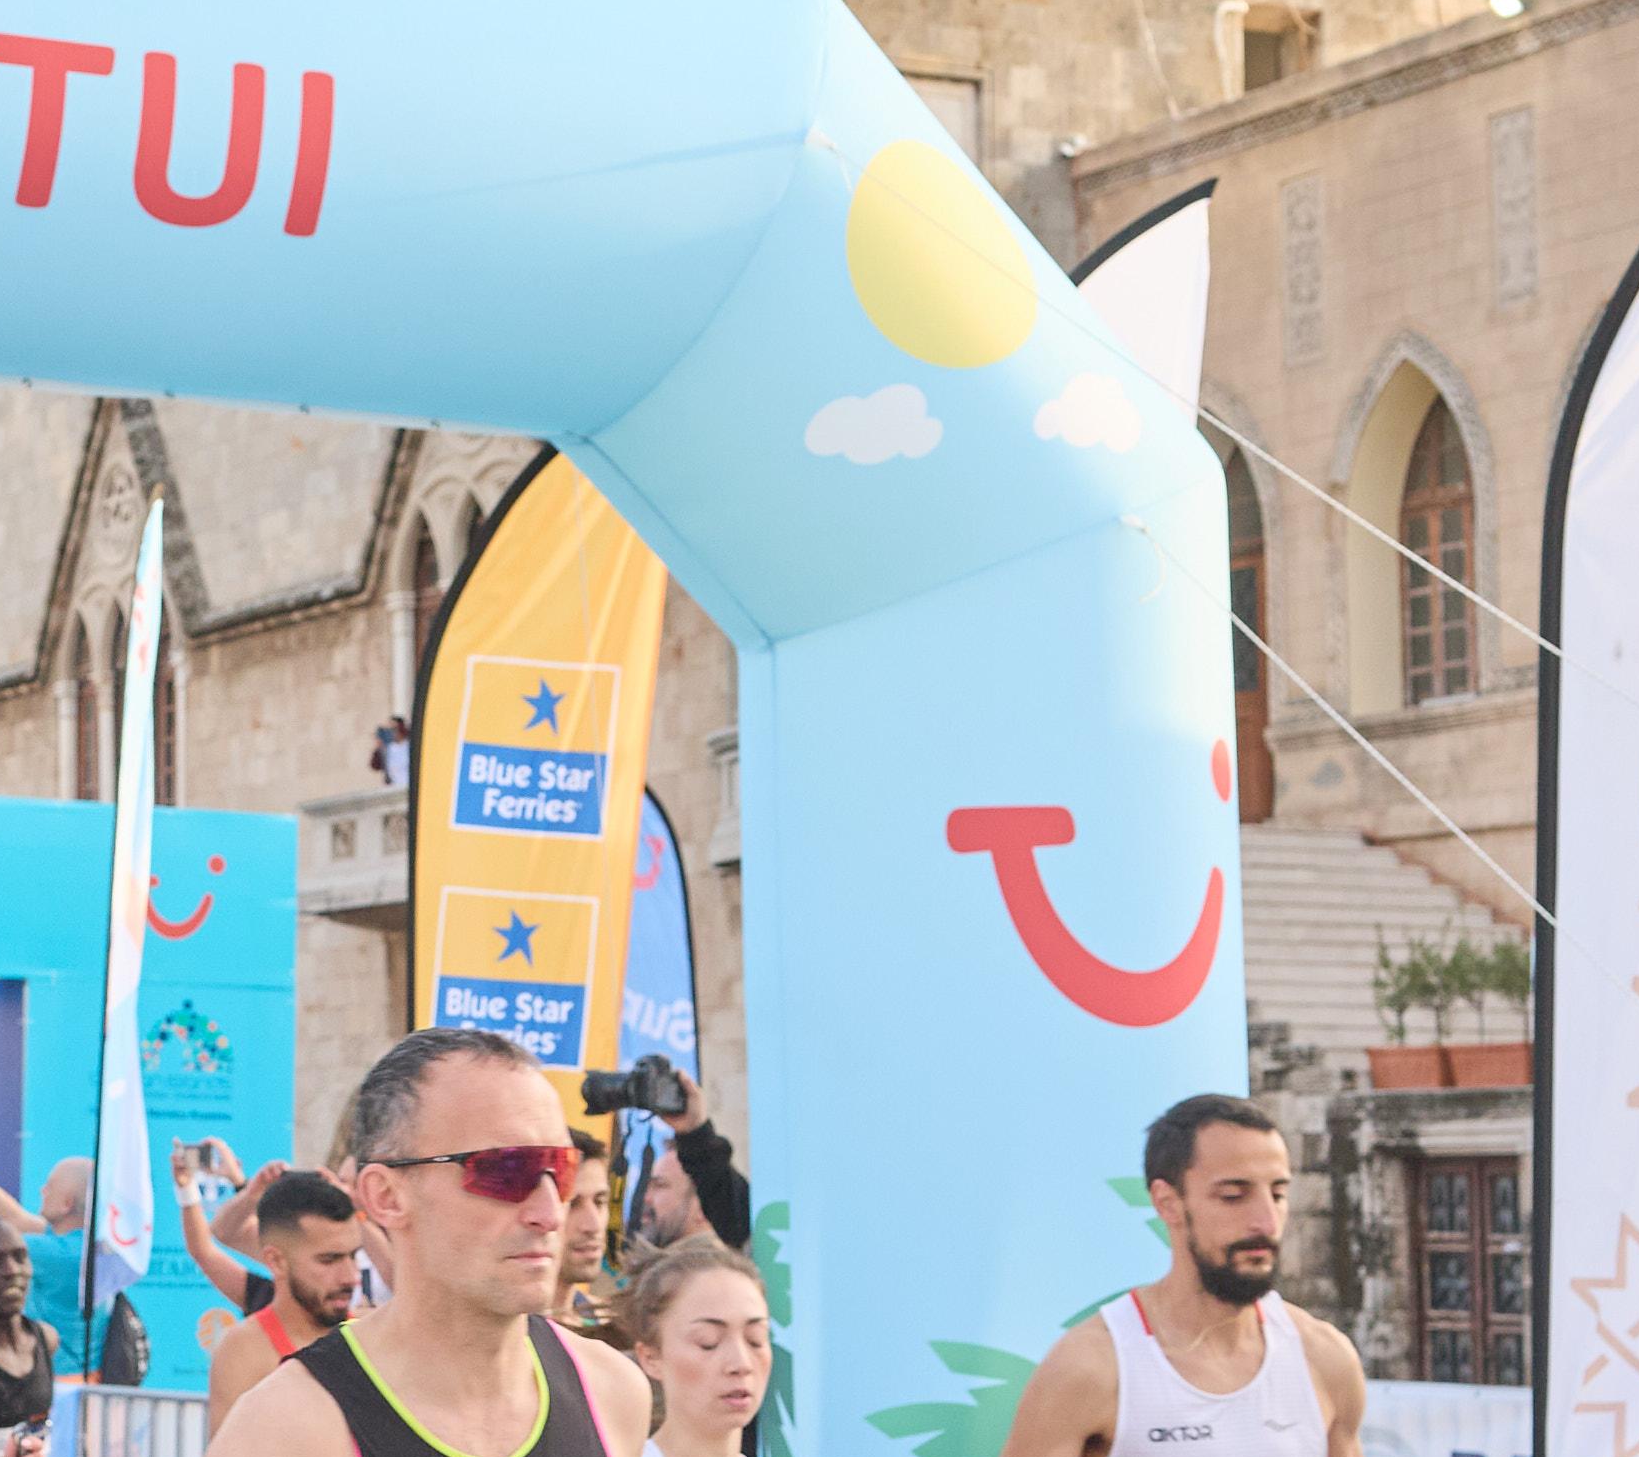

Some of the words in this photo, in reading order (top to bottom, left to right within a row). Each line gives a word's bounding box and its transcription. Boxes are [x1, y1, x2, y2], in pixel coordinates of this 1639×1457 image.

[469, 754, 531, 789] Blue
[540, 761, 595, 793] Star
[483, 788, 579, 823] Ferries
[445, 987, 508, 1020] Blue
[514, 991, 574, 1023] Star
